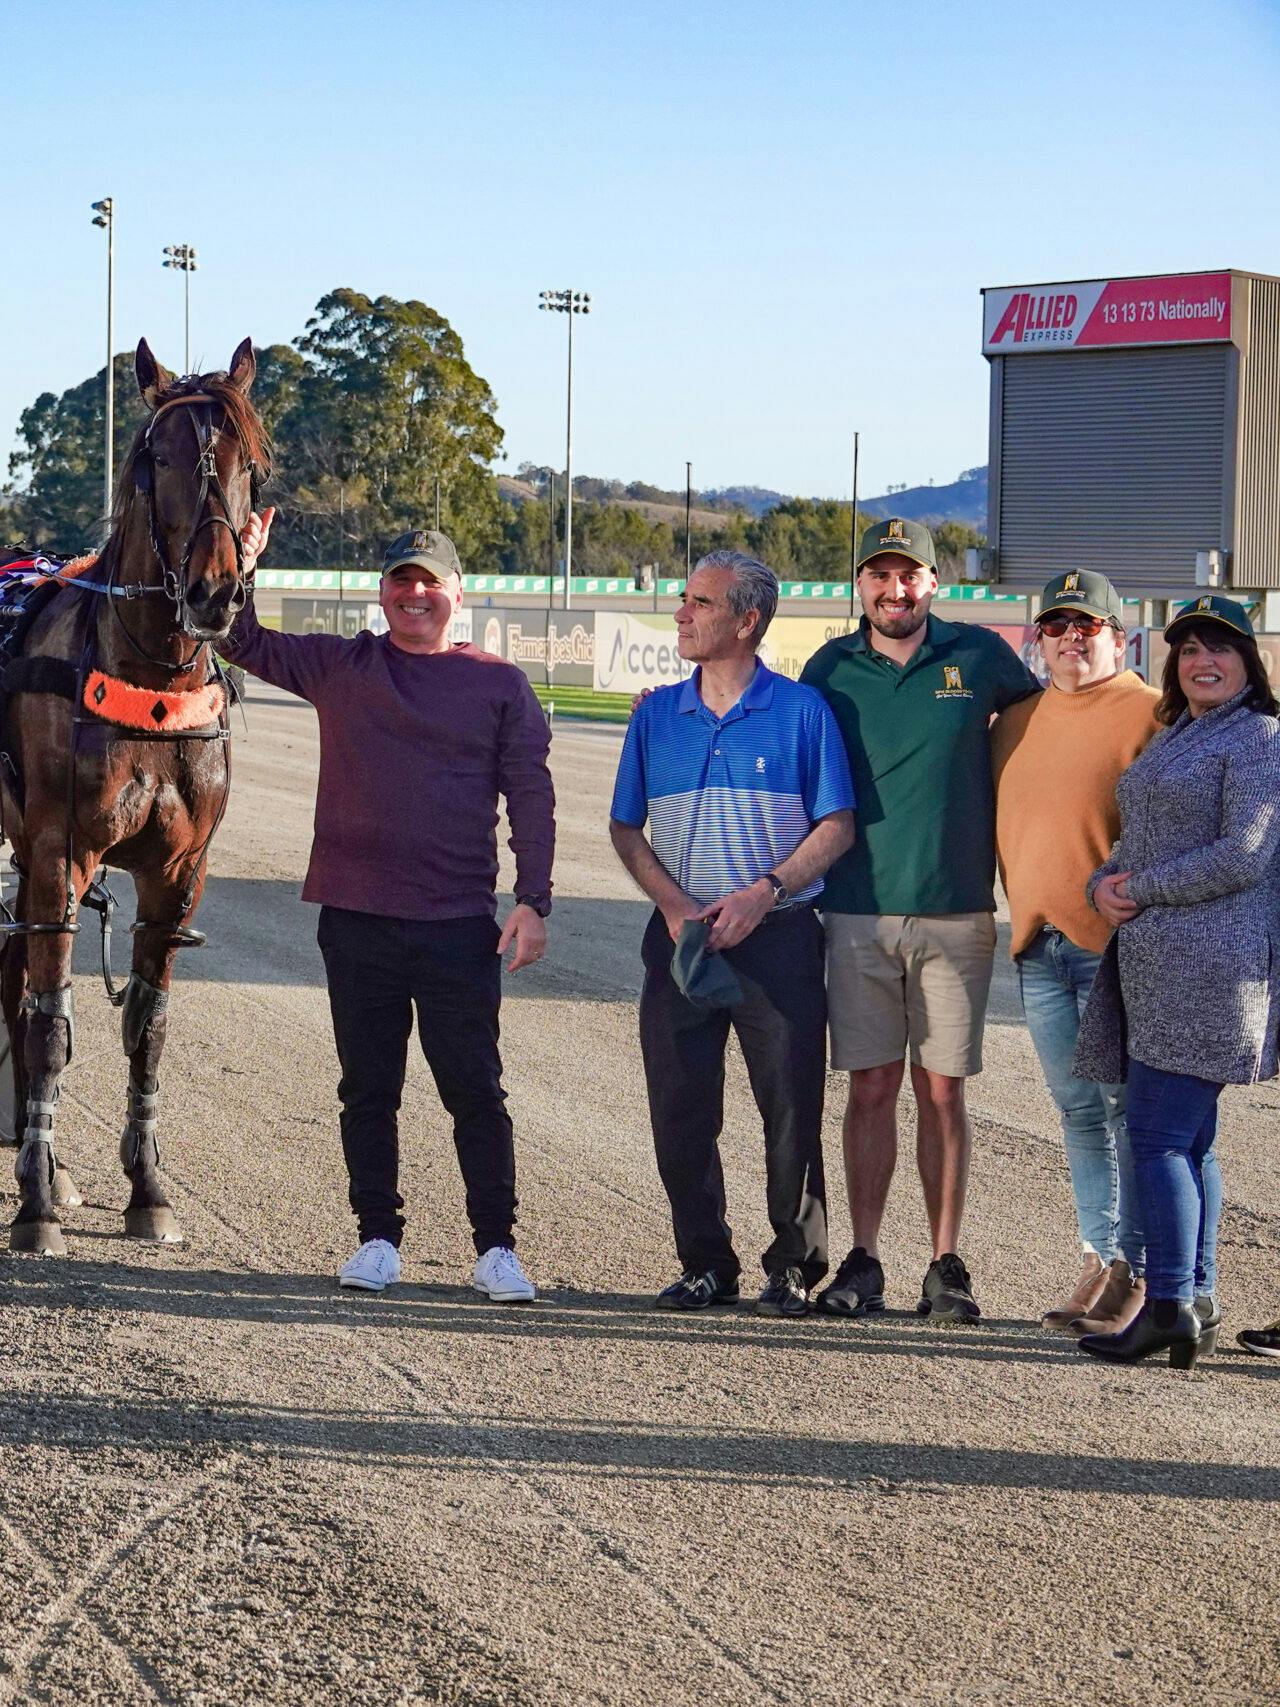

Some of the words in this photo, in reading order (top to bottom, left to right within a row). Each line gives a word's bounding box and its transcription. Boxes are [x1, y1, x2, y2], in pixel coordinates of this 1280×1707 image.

[989, 294, 1078, 344] ALLIED
[1103, 304, 1118, 323] 13
[1122, 302, 1136, 322] 13
[1140, 301, 1155, 321] 73
[1159, 297, 1226, 322] Nationally
[1024, 330, 1073, 342] EXPRESS
[507, 624, 548, 663] Farmer
[1129, 633, 1142, 666] 1
[765, 657, 790, 675] ndell
